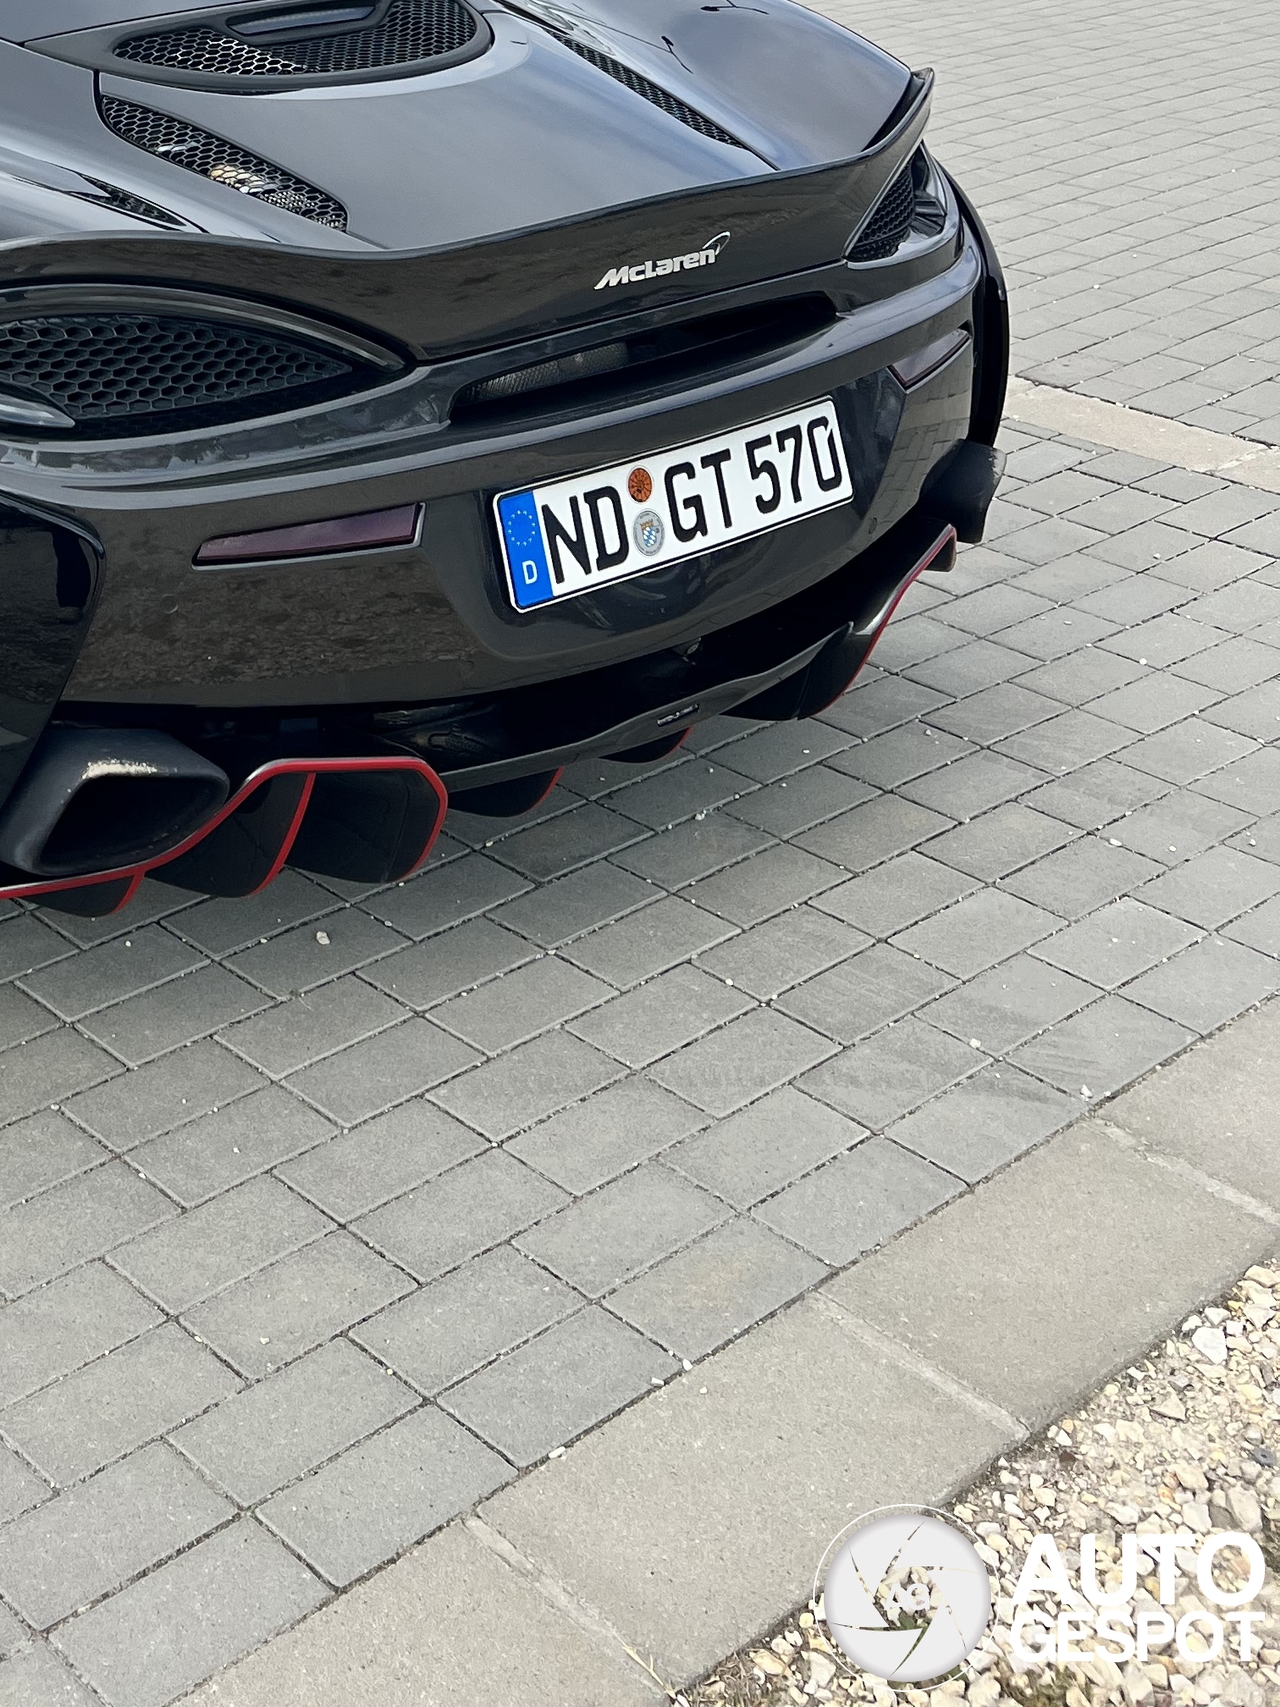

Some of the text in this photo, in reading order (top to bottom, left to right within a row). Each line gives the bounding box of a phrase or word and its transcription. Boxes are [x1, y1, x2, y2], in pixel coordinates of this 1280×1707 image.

[594, 246, 717, 290] McLaren
[542, 415, 842, 584] ND GT 570
[522, 560, 538, 585] D
